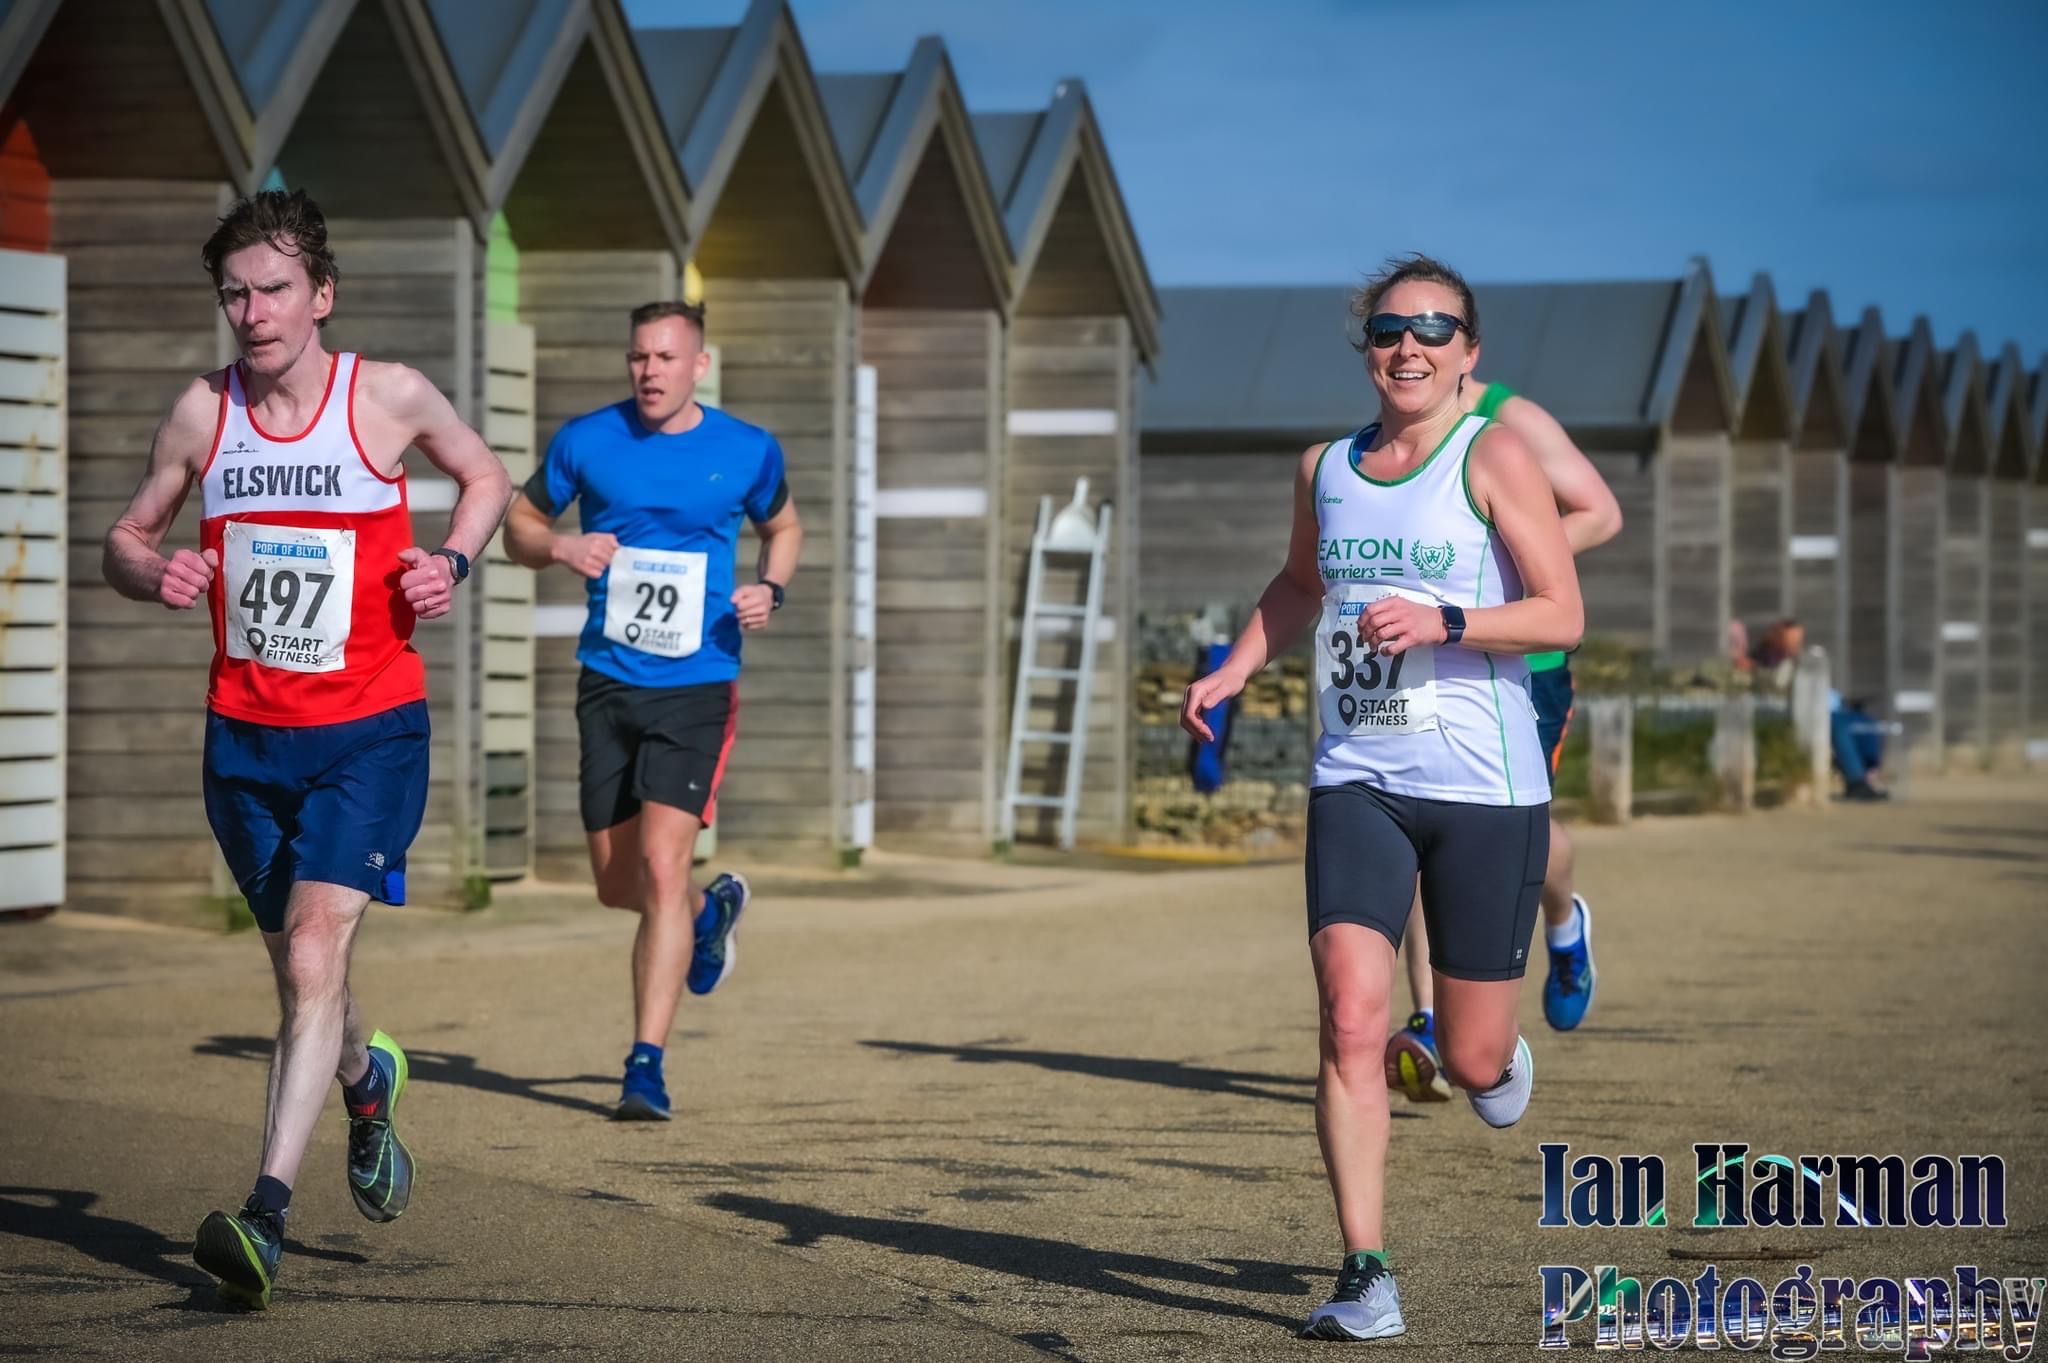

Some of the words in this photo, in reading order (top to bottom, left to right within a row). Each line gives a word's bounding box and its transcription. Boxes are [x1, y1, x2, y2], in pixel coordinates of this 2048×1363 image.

[223, 465, 342, 499] ELSWICK
[255, 543, 279, 554] PORT
[281, 545, 293, 556] OF
[296, 546, 324, 558] BLYTH
[1319, 538, 1403, 561] EATON
[1321, 564, 1376, 579] Harriers
[240, 568, 335, 629] 497
[635, 582, 679, 622] 29
[1341, 604, 1360, 614] PORT
[644, 627, 683, 641] START
[269, 634, 323, 653] START
[266, 649, 319, 665] FITNESS
[1331, 630, 1407, 690] 337
[1360, 699, 1409, 714] START
[1358, 715, 1408, 726] FITNESS
